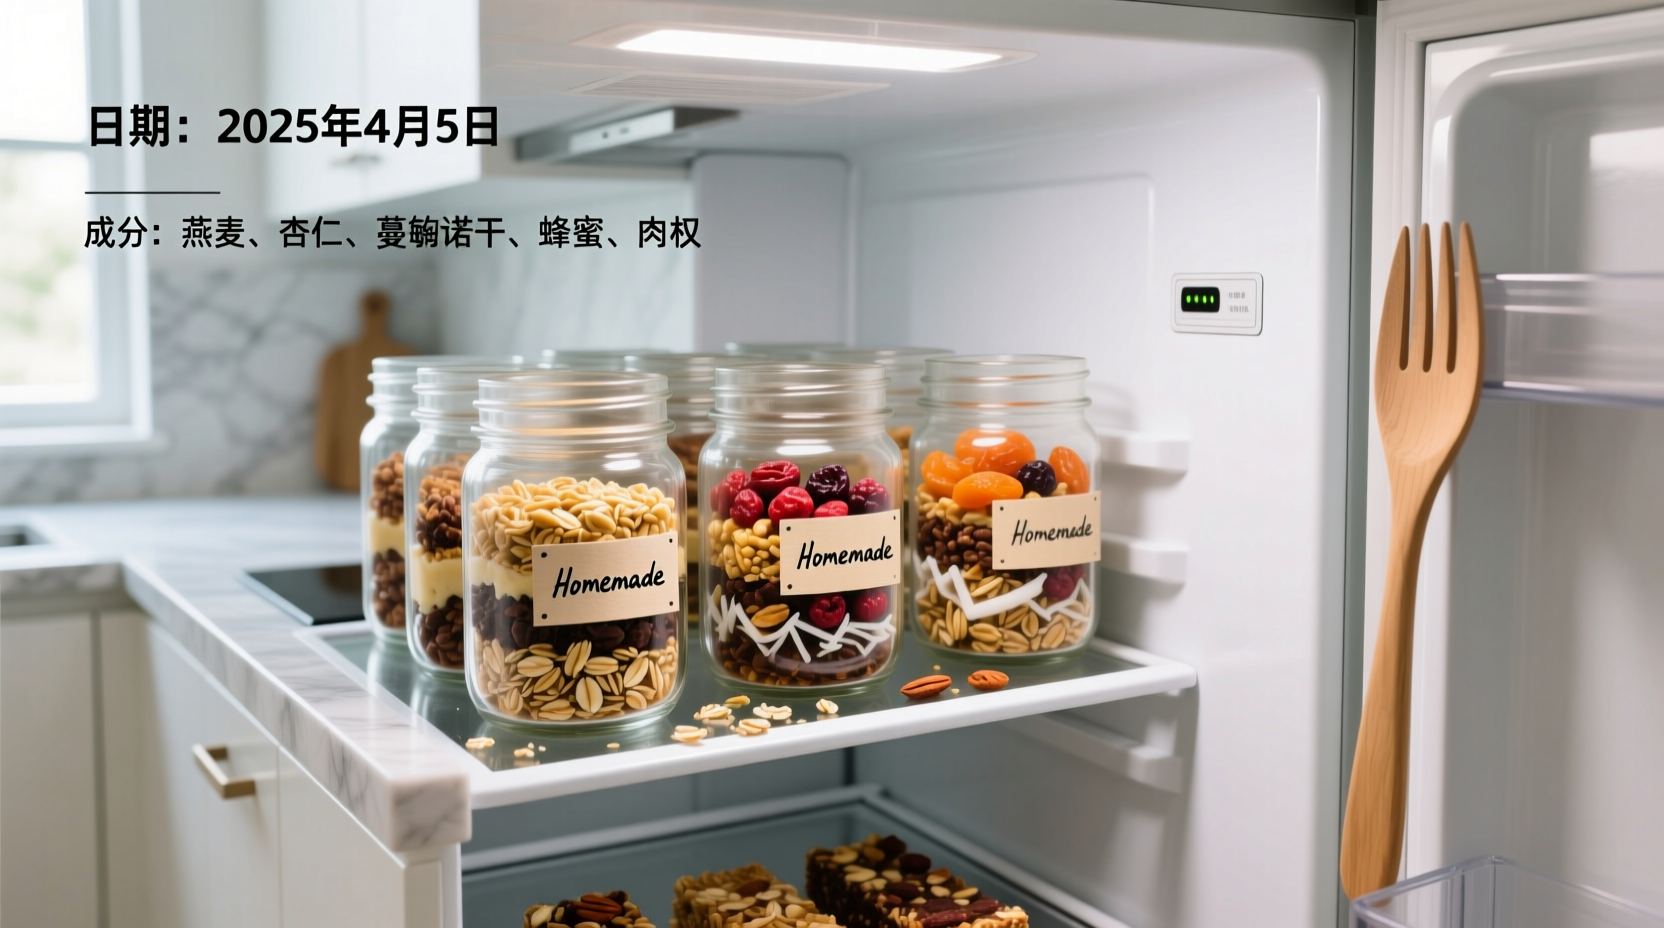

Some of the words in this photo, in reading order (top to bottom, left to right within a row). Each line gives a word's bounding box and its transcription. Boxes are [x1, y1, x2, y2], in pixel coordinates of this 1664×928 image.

[1010, 515, 1092, 546] Homemade
[796, 535, 894, 571] Homemade
[552, 561, 666, 599] Homemade
